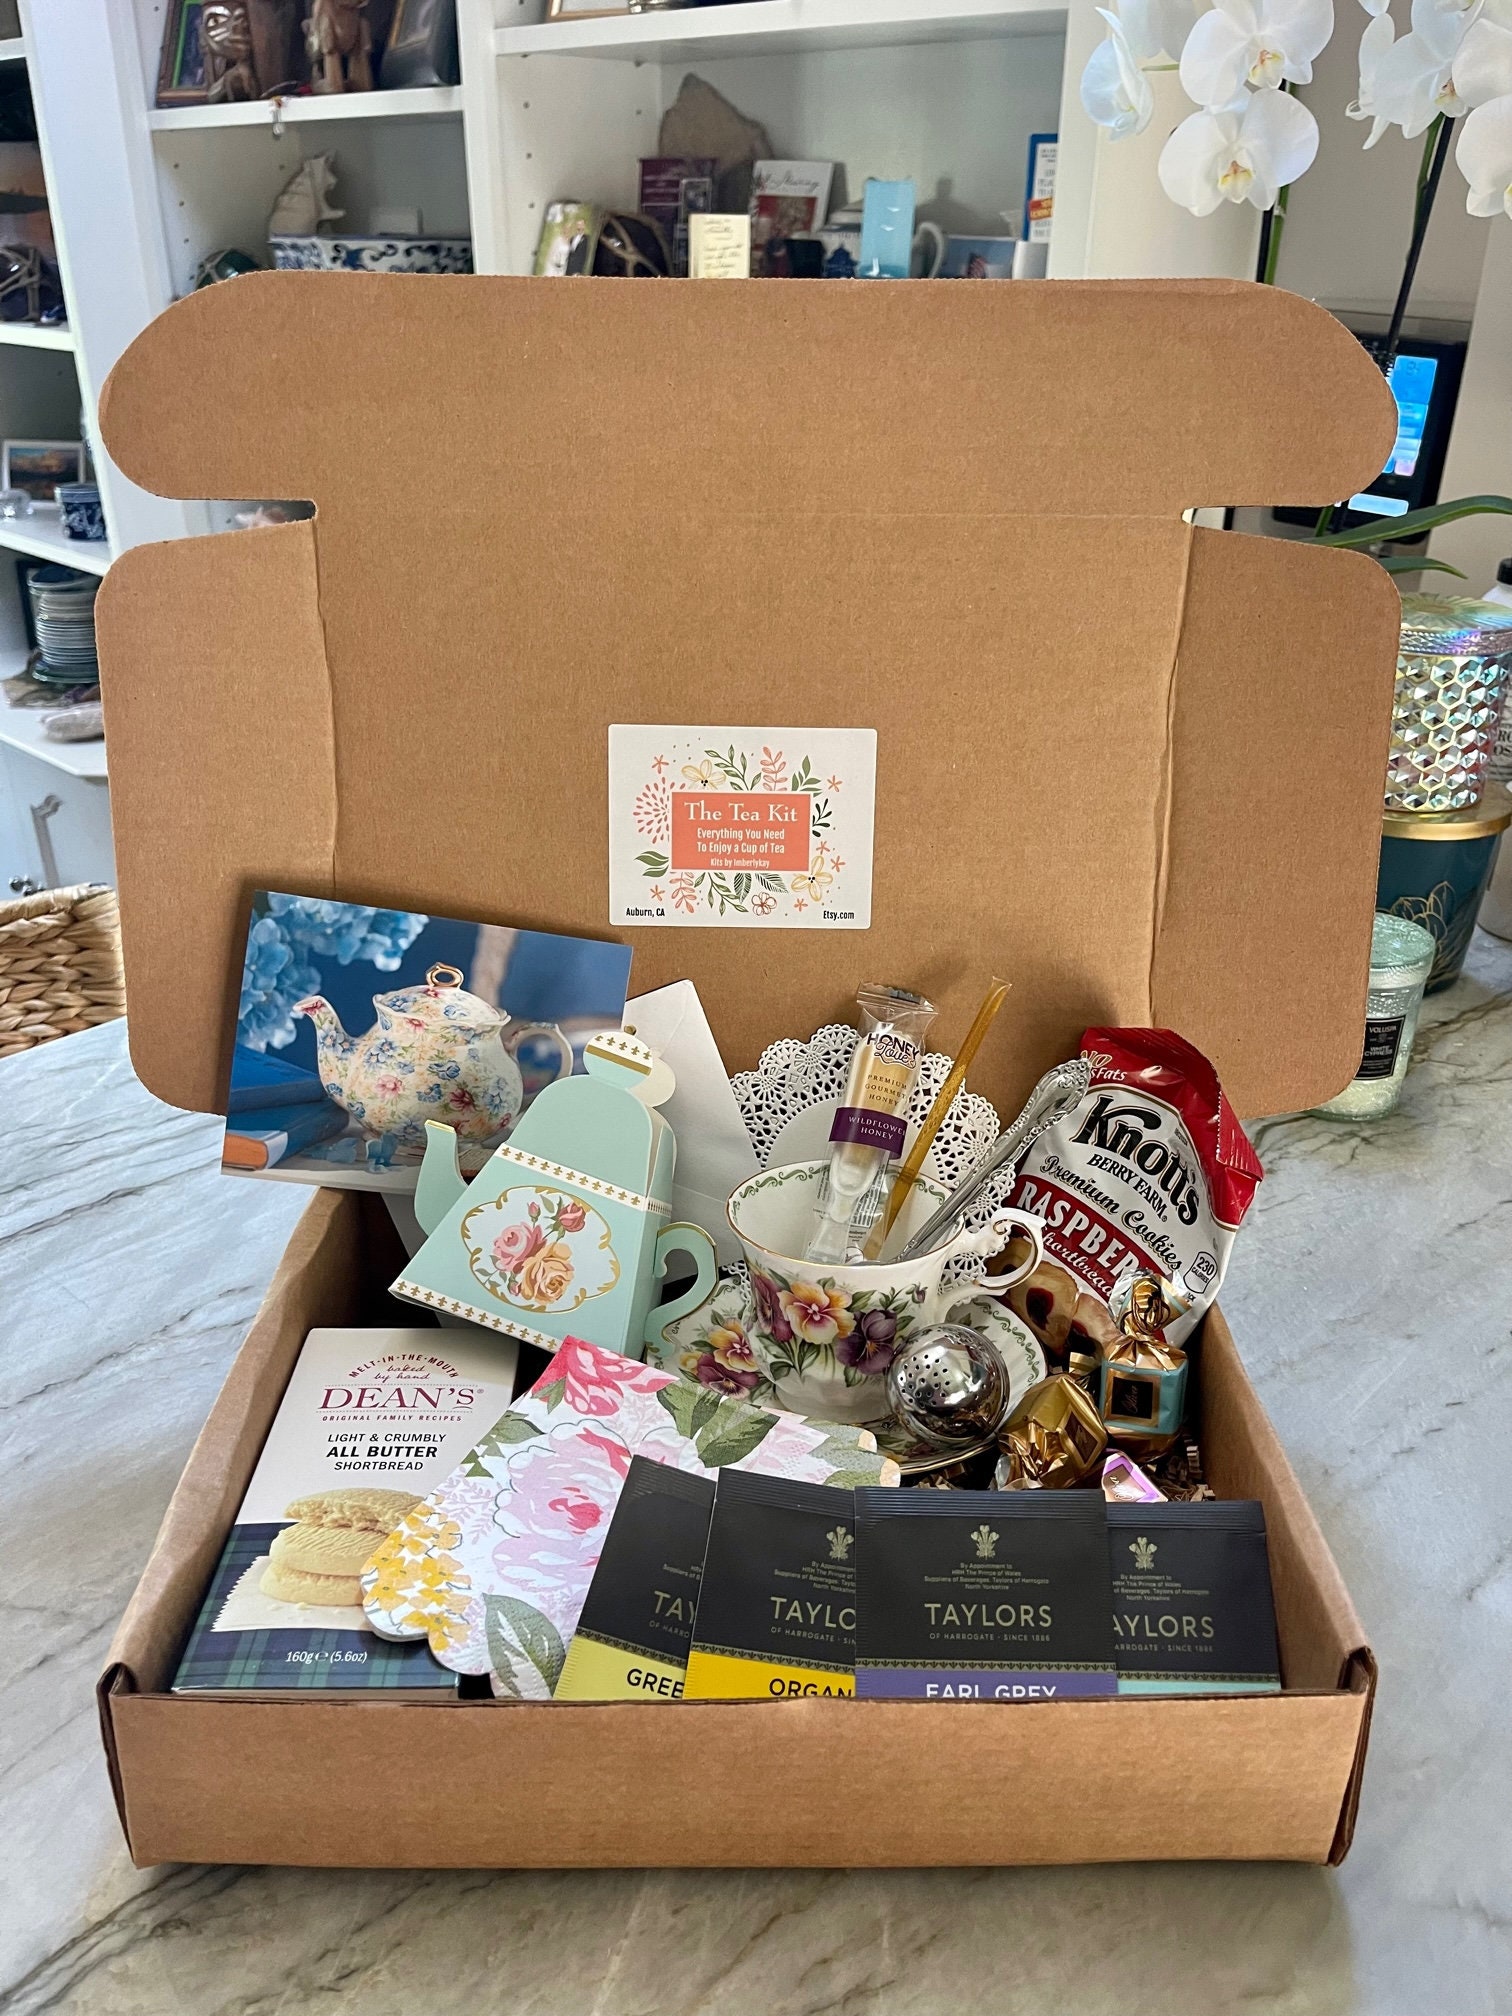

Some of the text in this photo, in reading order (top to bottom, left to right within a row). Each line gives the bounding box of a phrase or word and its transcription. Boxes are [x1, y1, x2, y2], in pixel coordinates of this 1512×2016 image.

[684, 799, 798, 822] The Tea Kit
[697, 827, 785, 841] Everything You Need
[697, 841, 785, 855] To Enjoy a Cup of Tea
[724, 858, 733, 868] by
[626, 907, 665, 918] Auburn, CA
[823, 910, 855, 921] Etsy.com
[866, 1033, 920, 1060] HONEY
[867, 1074, 907, 1089] PREMIUM
[865, 1083, 906, 1099] GOURMET
[869, 1094, 899, 1106] HONEY
[861, 1127, 893, 1140] HONEY
[1070, 1094, 1199, 1225] Knott's
[1086, 1154, 1139, 1185] BERRY
[1040, 1155, 1183, 1271] Premium Cookies
[1196, 1256, 1215, 1277] 230
[387, 1364, 425, 1372] baked
[374, 1372, 431, 1384] by hand
[322, 1414, 462, 1422] ORIGINAL FAMILY RECIPES
[327, 1433, 448, 1443] LIGHT & CRUMBLY
[326, 1446, 438, 1458] ALL BUTTER
[333, 1461, 424, 1471] SHORTBREAD
[770, 1596, 856, 1631] TAYLO
[924, 1603, 1052, 1628] TAYLORS
[785, 1628, 835, 1642] HARROGATE
[929, 1632, 940, 1640] OF
[944, 1633, 994, 1641] HARROGATE
[1167, 1644, 1192, 1652] SINCE
[626, 1668, 685, 1699] GREE
[926, 1683, 1057, 1698] EARL GREY
